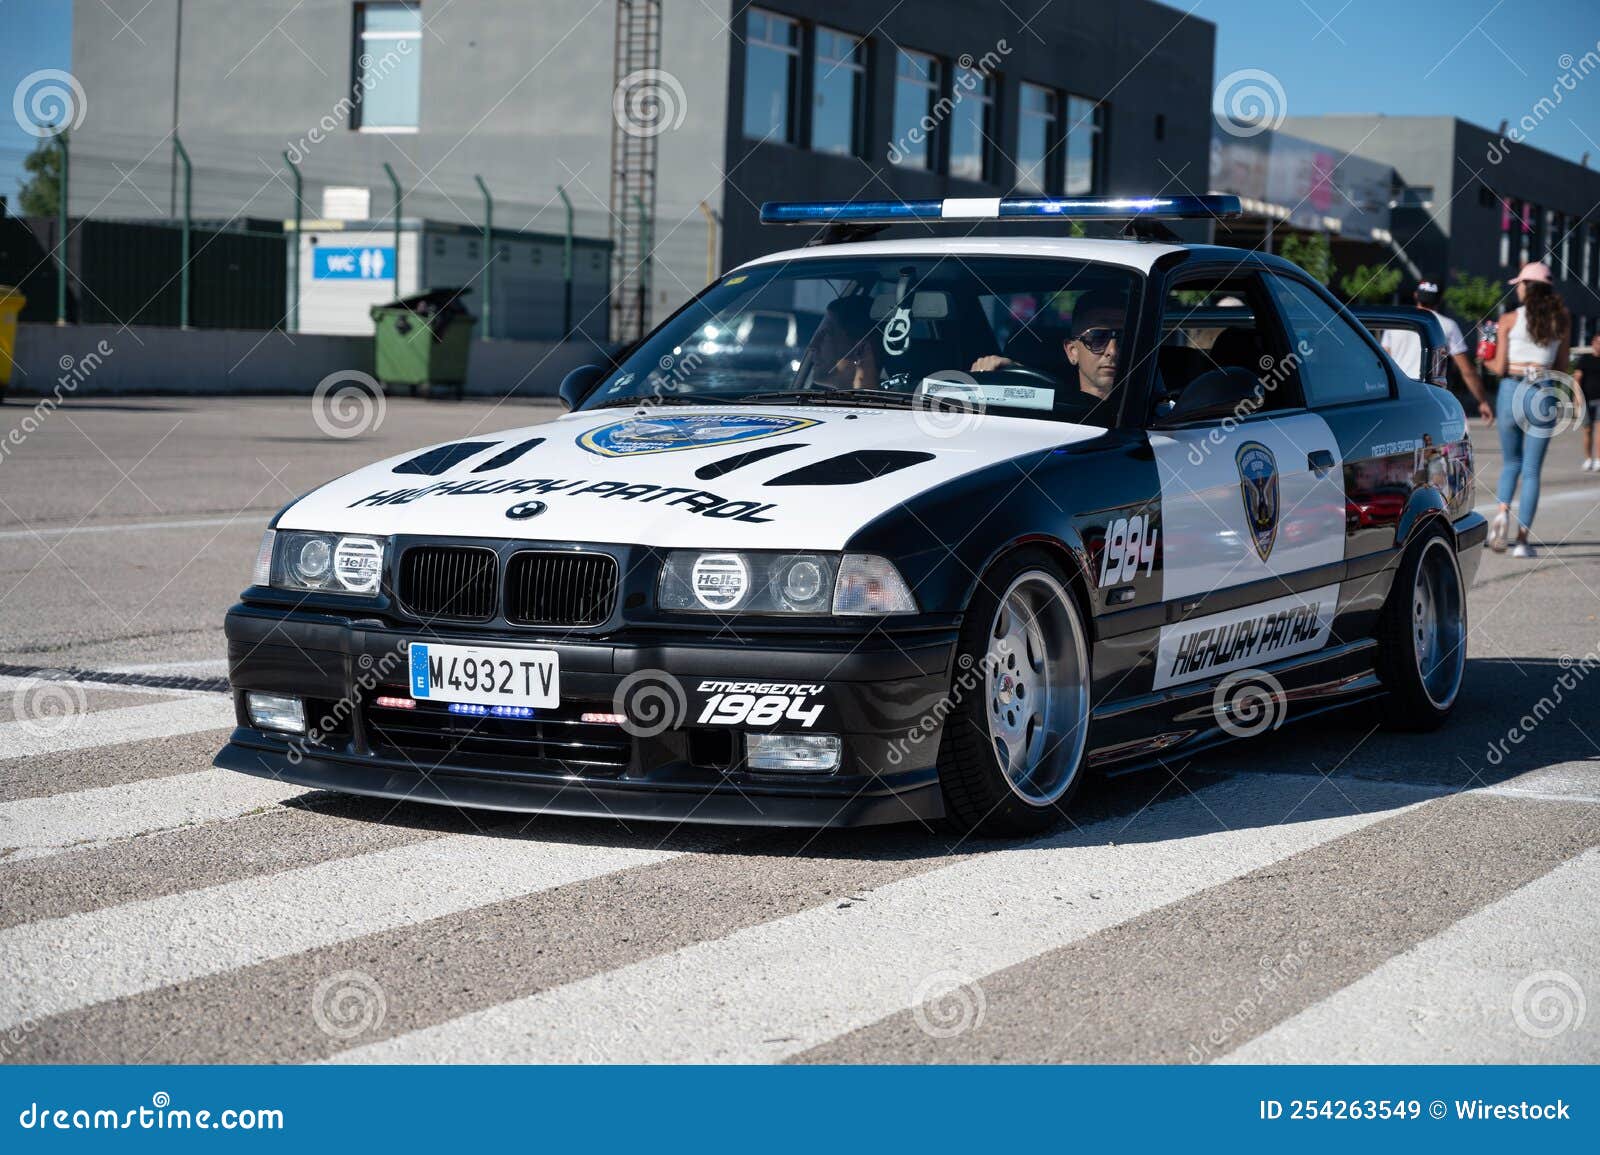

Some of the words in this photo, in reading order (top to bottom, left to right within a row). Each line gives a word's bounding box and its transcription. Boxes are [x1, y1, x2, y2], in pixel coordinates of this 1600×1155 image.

[327, 255, 355, 272] WC
[346, 479, 588, 508] HIGHWAY
[567, 481, 778, 523] PATROL
[1099, 514, 1157, 588] 1984
[339, 558, 377, 567] Hella
[698, 574, 741, 585] Hella
[1171, 616, 1265, 677] HIGHWAY
[1257, 602, 1321, 654] PATROL
[417, 676, 425, 688] E
[697, 681, 825, 696] EMERGENCY
[697, 693, 825, 727] 1984
